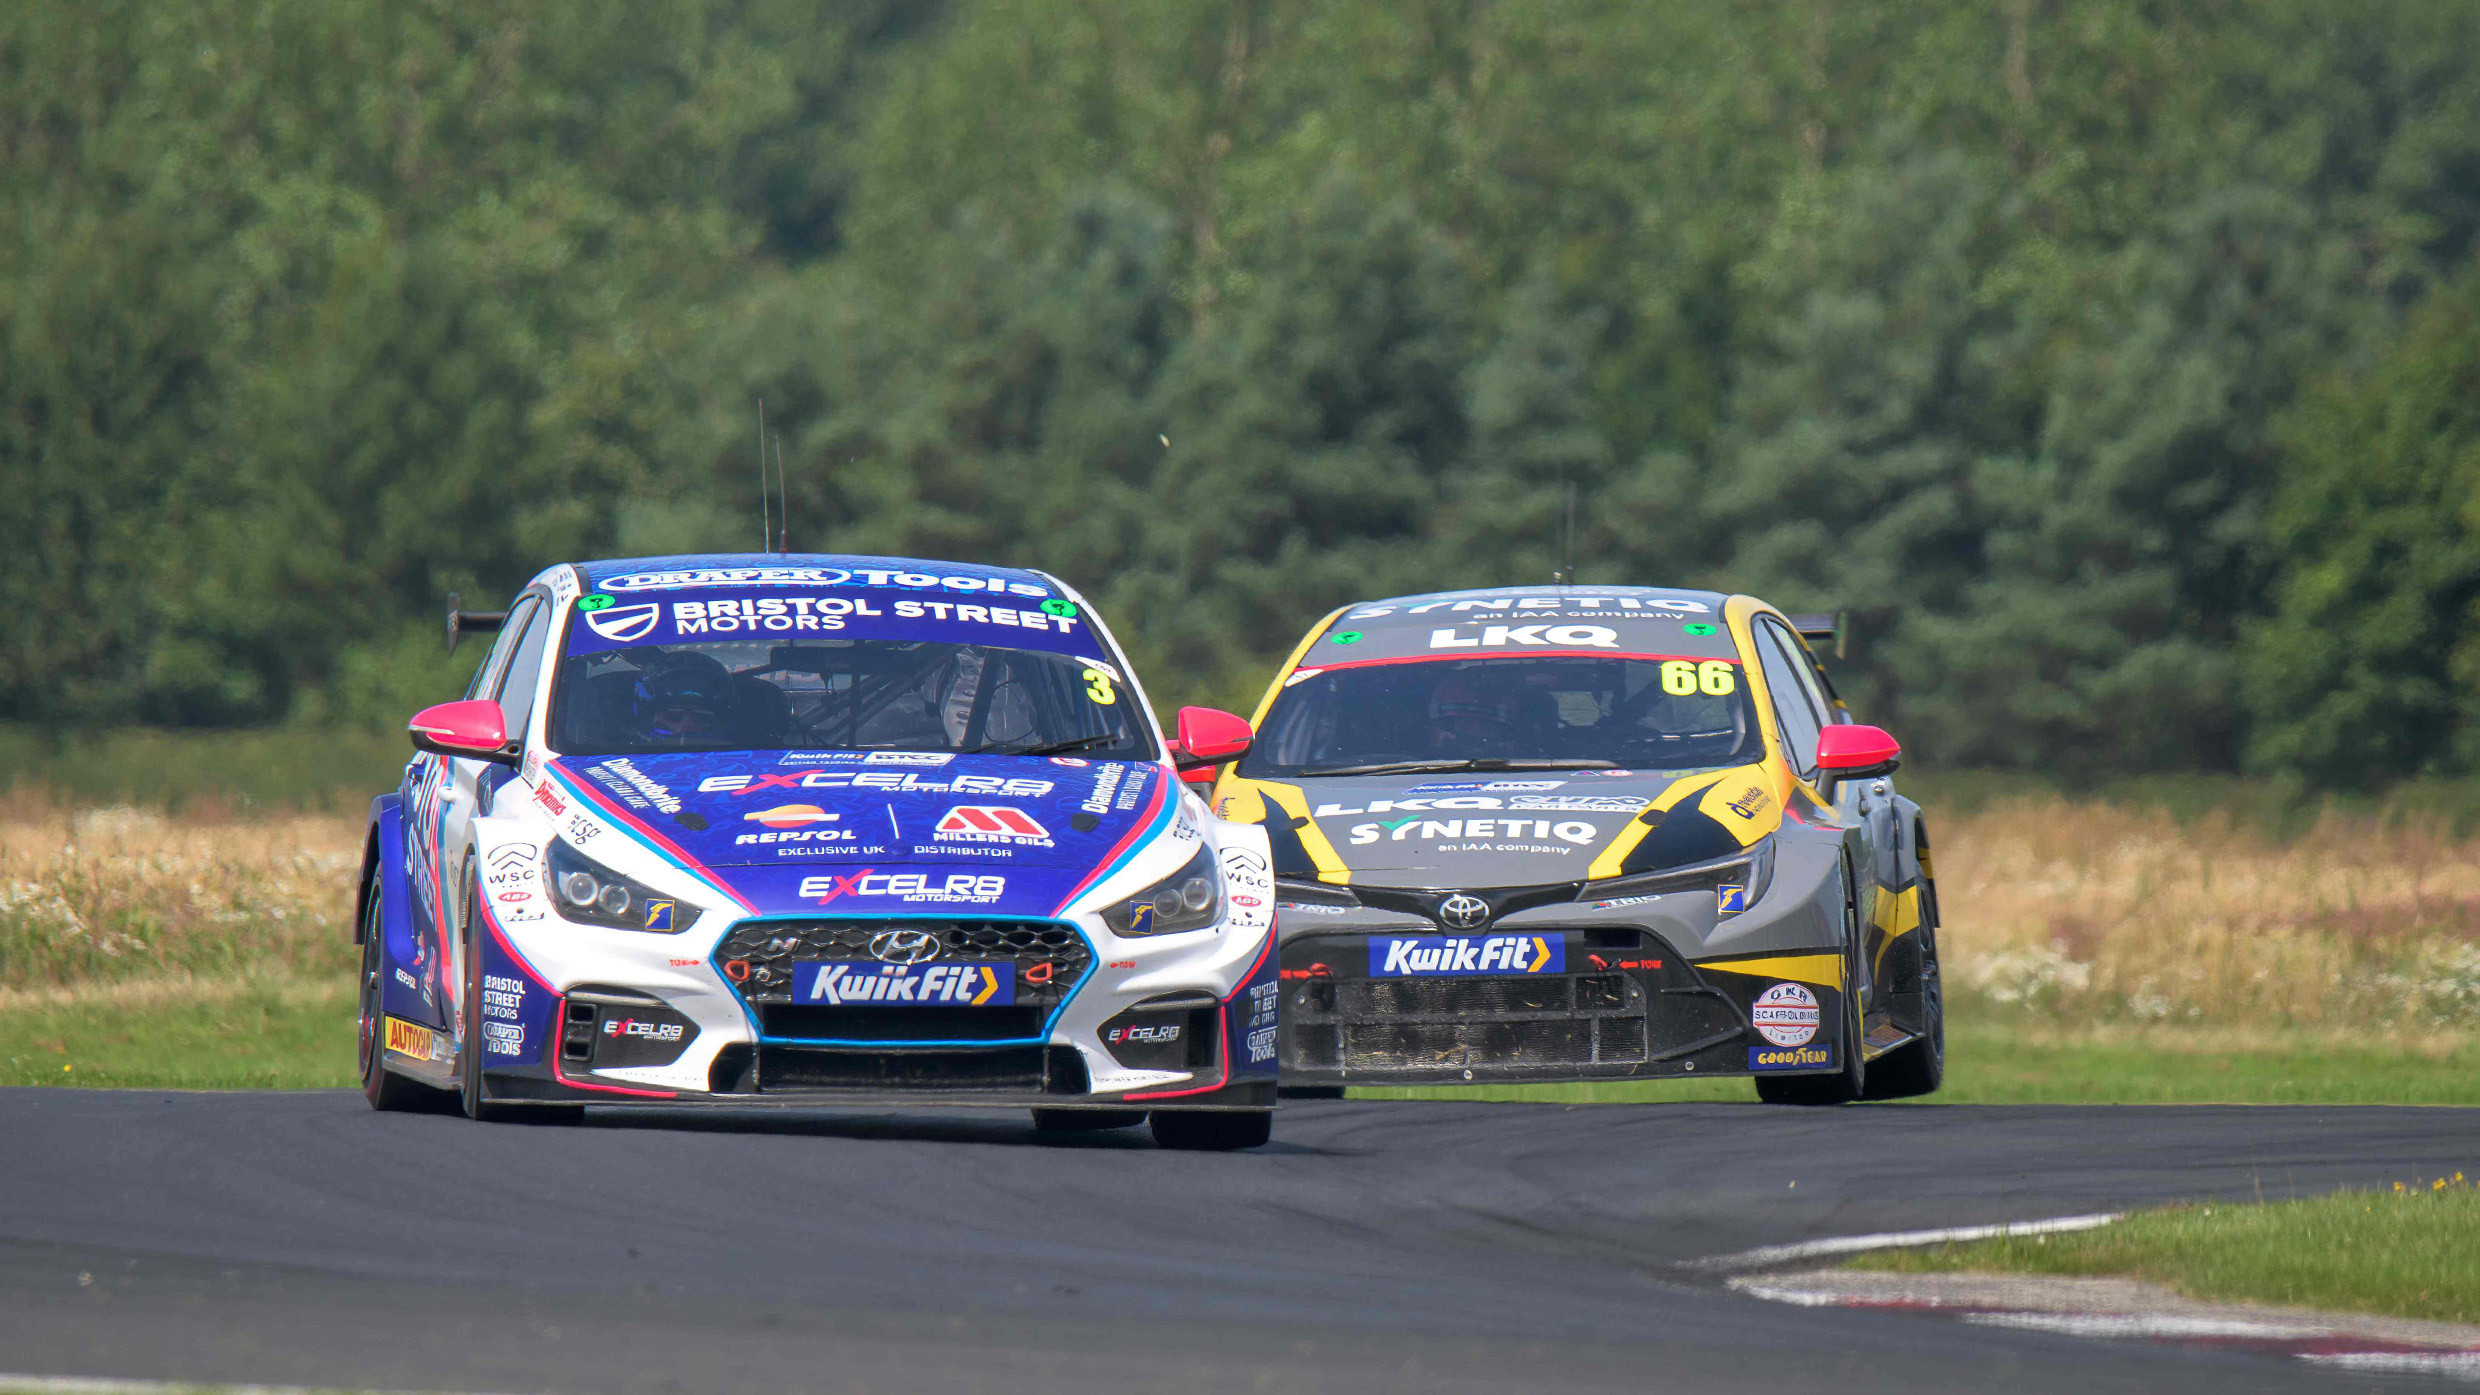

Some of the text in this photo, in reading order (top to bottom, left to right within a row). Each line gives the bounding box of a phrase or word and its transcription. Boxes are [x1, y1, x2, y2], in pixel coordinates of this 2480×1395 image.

[623, 569, 1049, 597] DRAPER Tools
[673, 597, 1078, 634] BRISTOL STREET
[1349, 597, 1711, 620] SYNETIQ
[1473, 610, 1685, 620] an IAA company
[676, 615, 846, 635] MOTORS
[1429, 624, 1621, 649] LKQ
[1082, 668, 1117, 705] 3
[1660, 659, 1736, 697] 66
[697, 769, 1055, 796] EXCELR8
[881, 786, 1047, 798] MOTORSPORT
[1314, 796, 1504, 818] LKQ
[735, 829, 857, 846] REPSOL
[933, 832, 1056, 848] MILLERS OILS
[1349, 814, 1597, 846] SYNETIQ
[778, 845, 1013, 857] EXCLUSIVE UK DISTRIBUTOR
[1437, 843, 1571, 856] an IAA company
[488, 870, 535, 884] WSC
[798, 868, 1006, 905] EXCELR8
[1225, 870, 1269, 889] WSC
[903, 893, 1001, 904] MOTORSPORT
[484, 974, 527, 995] BRISTOL
[484, 989, 522, 1009] STREET
[1754, 1010, 1819, 1020] SCAFFOLDING
[603, 1017, 684, 1038] EXCELR8
[1757, 1047, 1827, 1066] GOODYEAR
